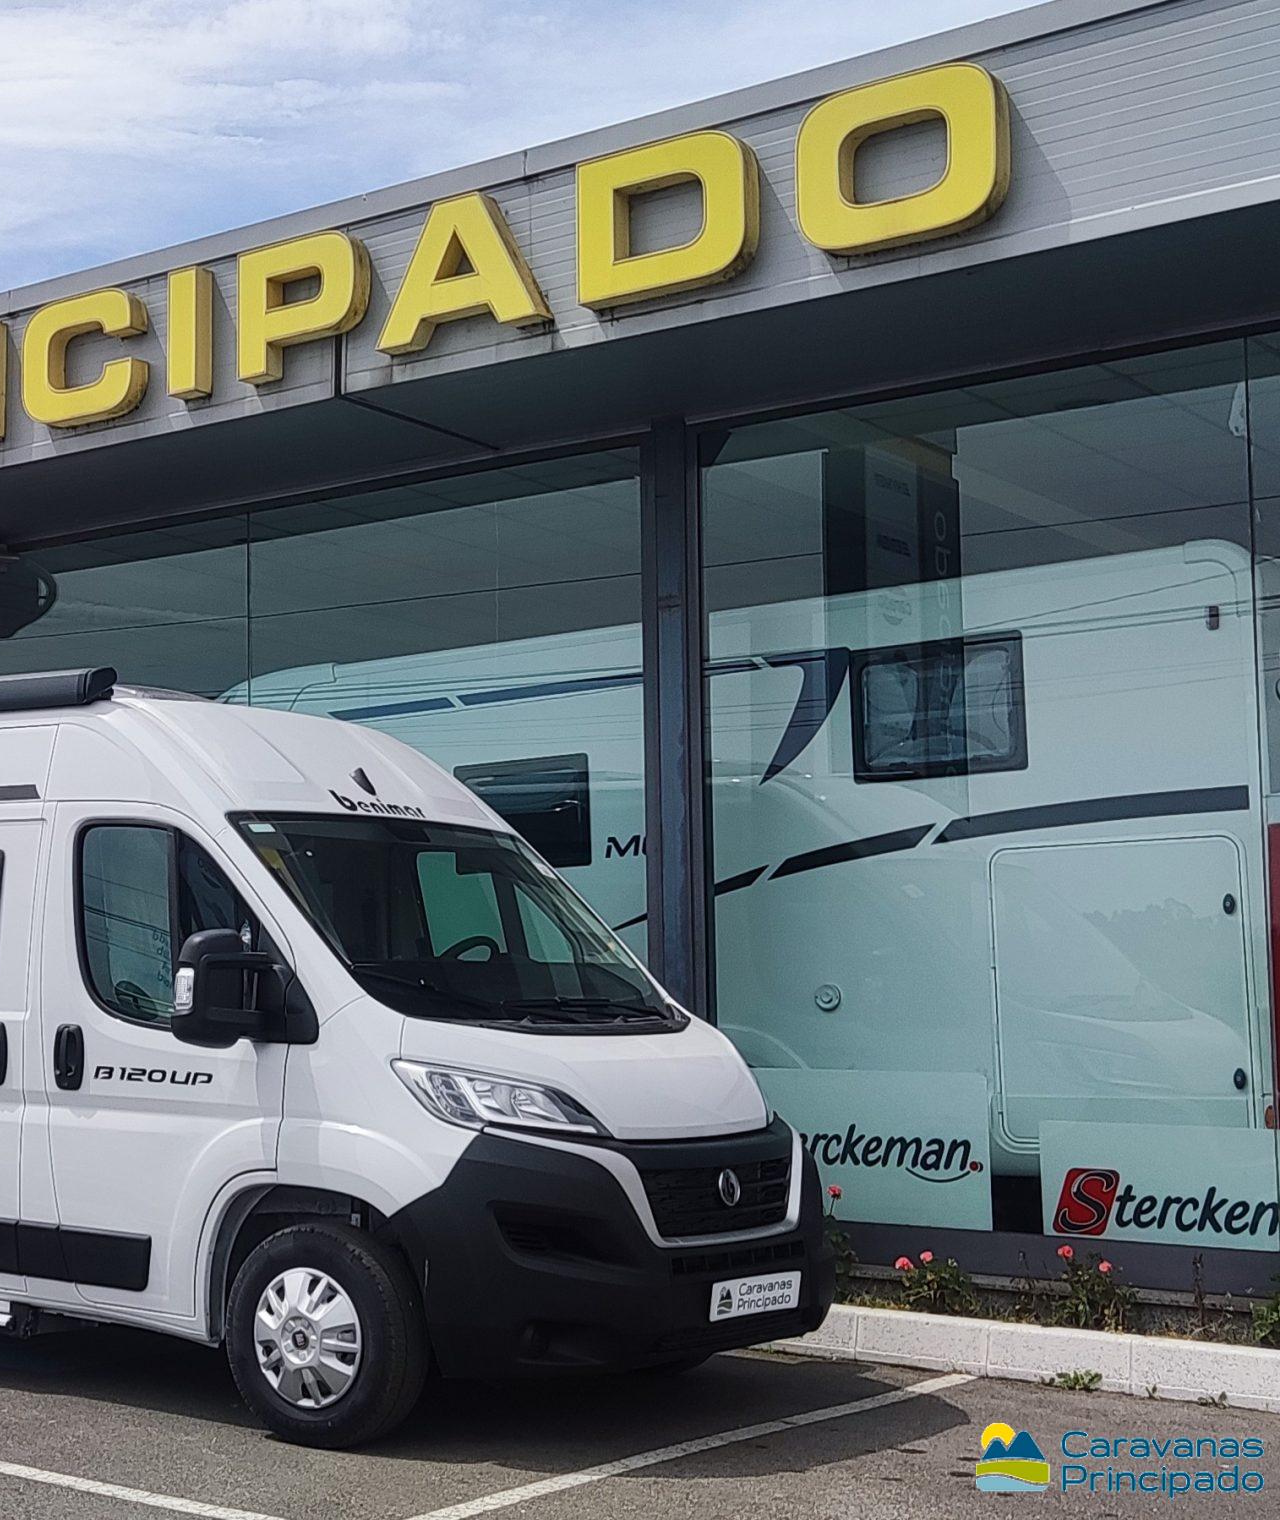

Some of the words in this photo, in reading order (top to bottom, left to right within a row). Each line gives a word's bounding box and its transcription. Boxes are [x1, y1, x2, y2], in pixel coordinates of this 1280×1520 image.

[327, 788, 427, 819] benimar
[738, 1279, 793, 1297] Caravanas
[737, 1292, 792, 1311] Principado
